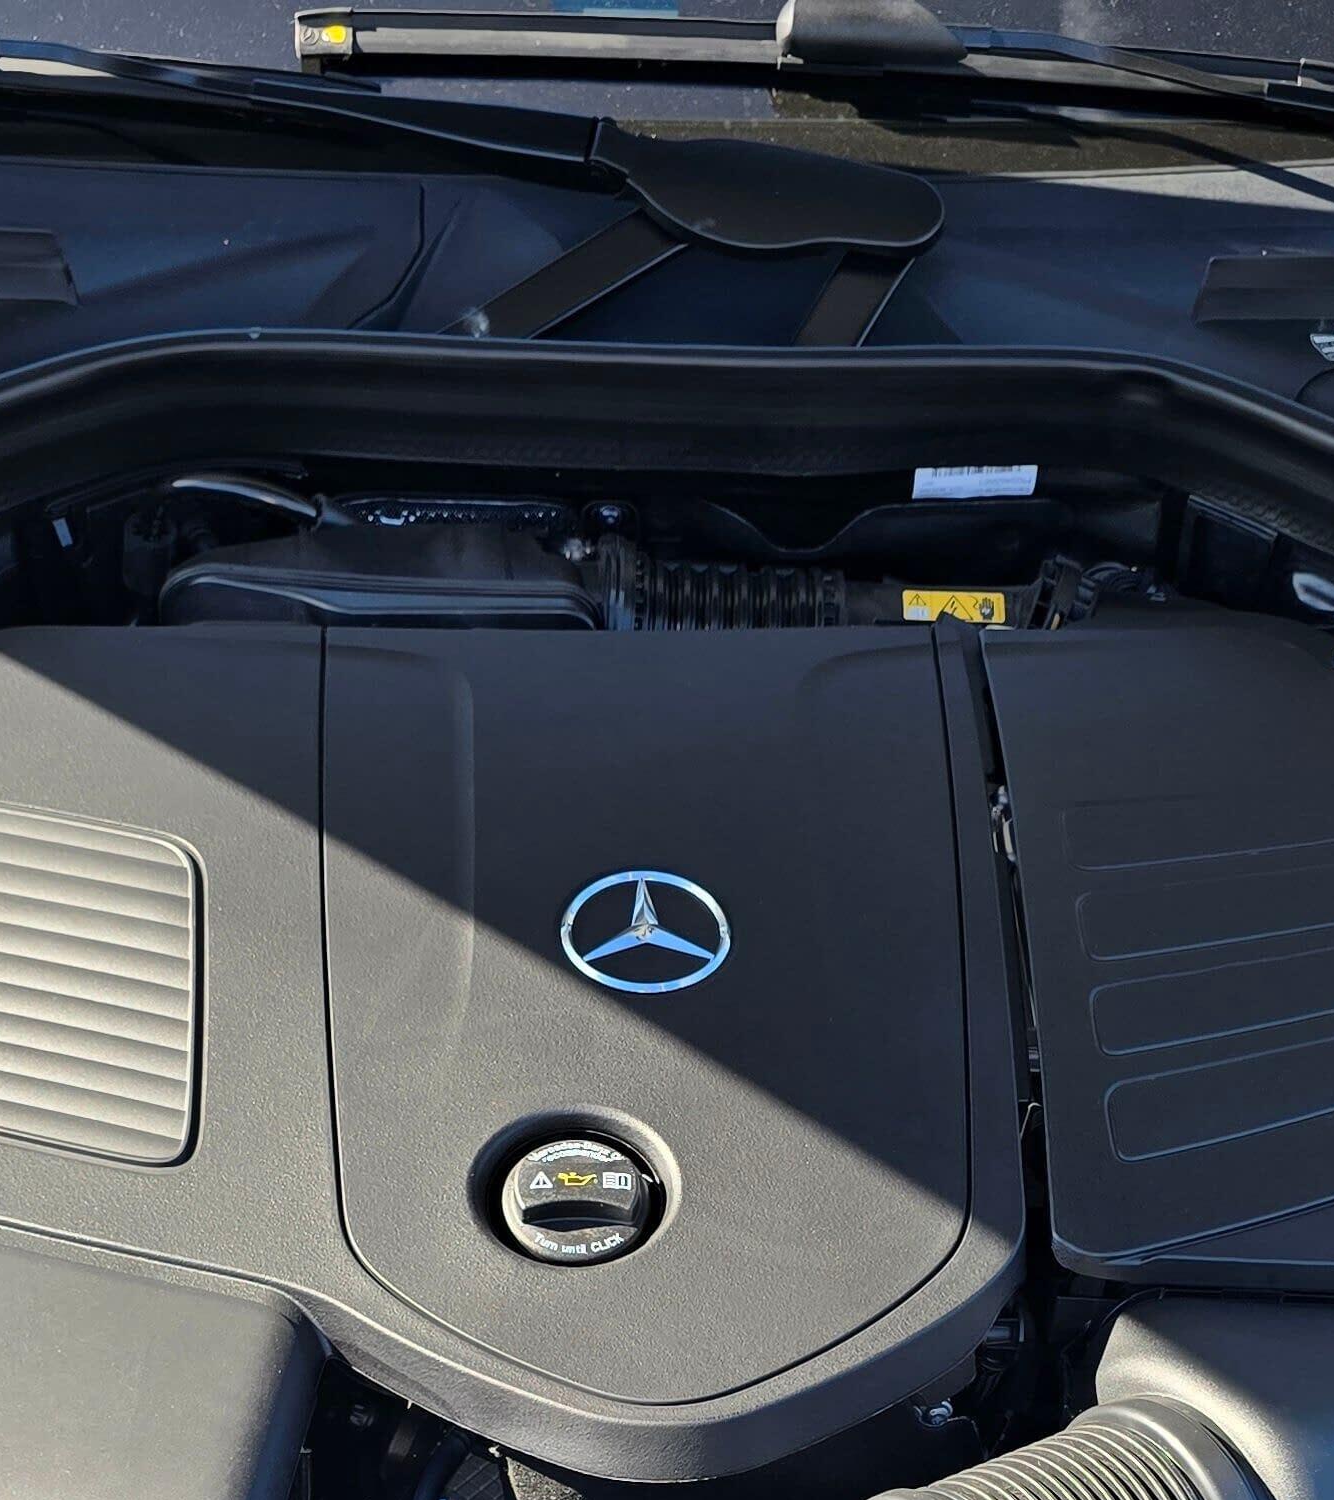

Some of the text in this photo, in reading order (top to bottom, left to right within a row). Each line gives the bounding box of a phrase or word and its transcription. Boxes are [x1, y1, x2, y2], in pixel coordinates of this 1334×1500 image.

[533, 1232, 625, 1255] Turn until CLICK
